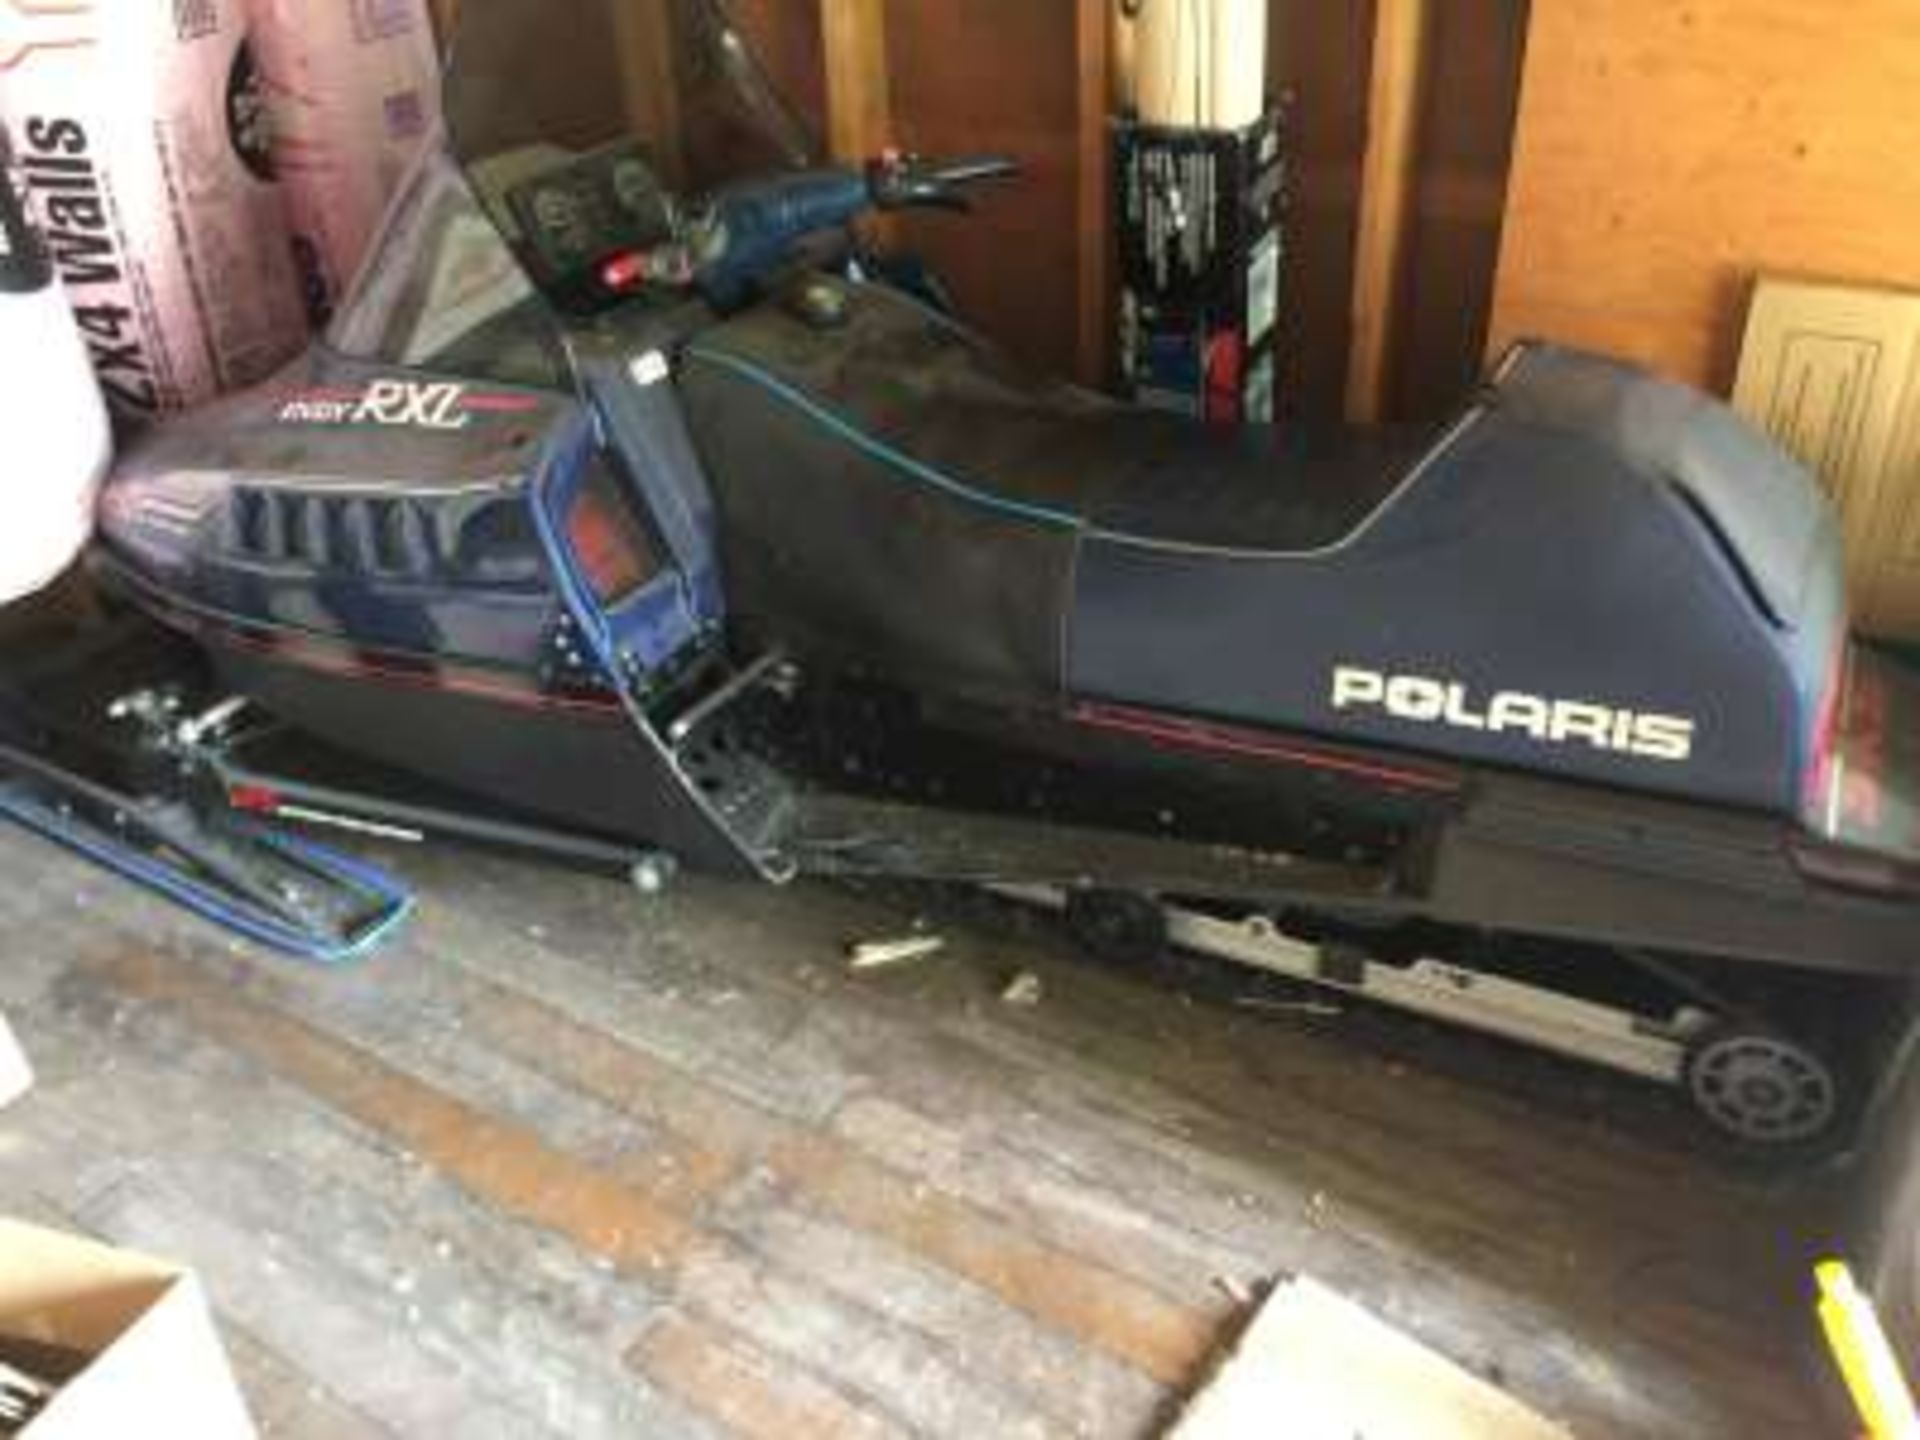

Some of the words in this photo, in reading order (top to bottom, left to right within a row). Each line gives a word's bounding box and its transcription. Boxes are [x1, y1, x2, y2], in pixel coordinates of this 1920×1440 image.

[24, 116, 121, 285] Walls
[353, 379, 470, 428] RXL
[1332, 665, 1695, 760] POLARIS
